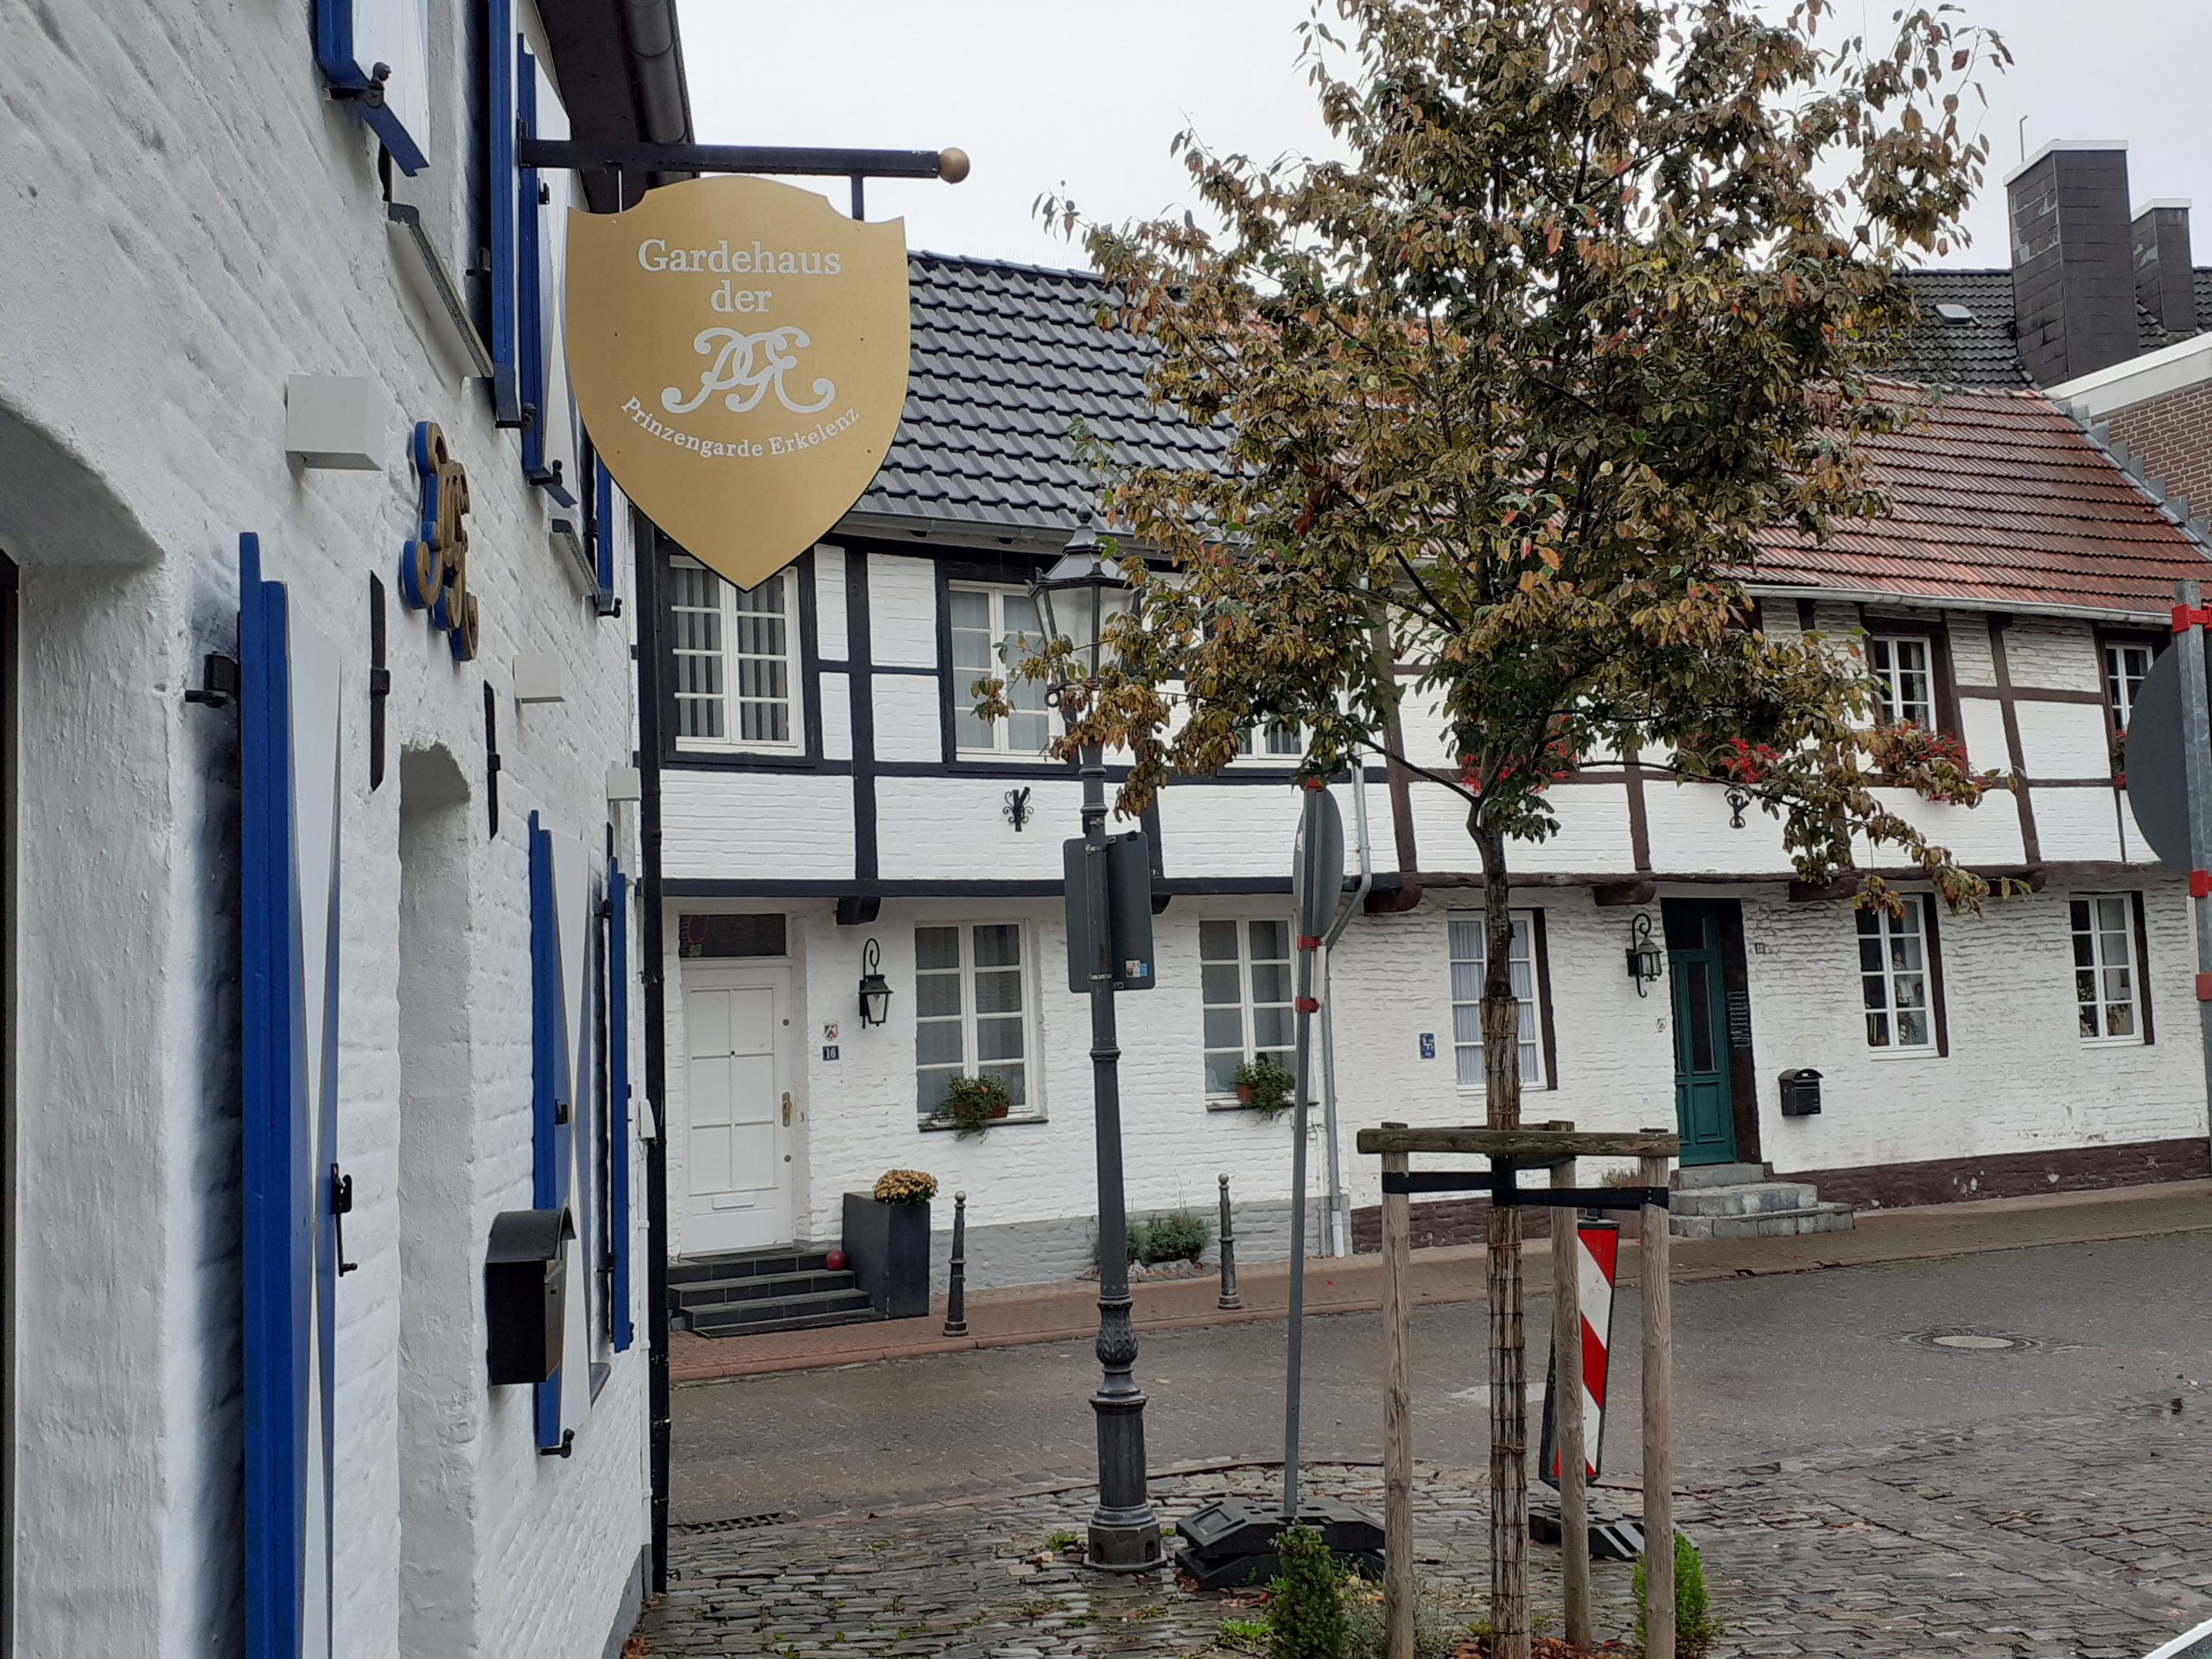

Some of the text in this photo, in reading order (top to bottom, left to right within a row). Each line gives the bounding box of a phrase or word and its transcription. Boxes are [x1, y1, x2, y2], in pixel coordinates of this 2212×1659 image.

[638, 238, 842, 275] Gardehaus
[710, 279, 772, 313] der
[620, 395, 861, 459] Prinzengarde Erkelenz
[825, 1046, 837, 1059] 16
